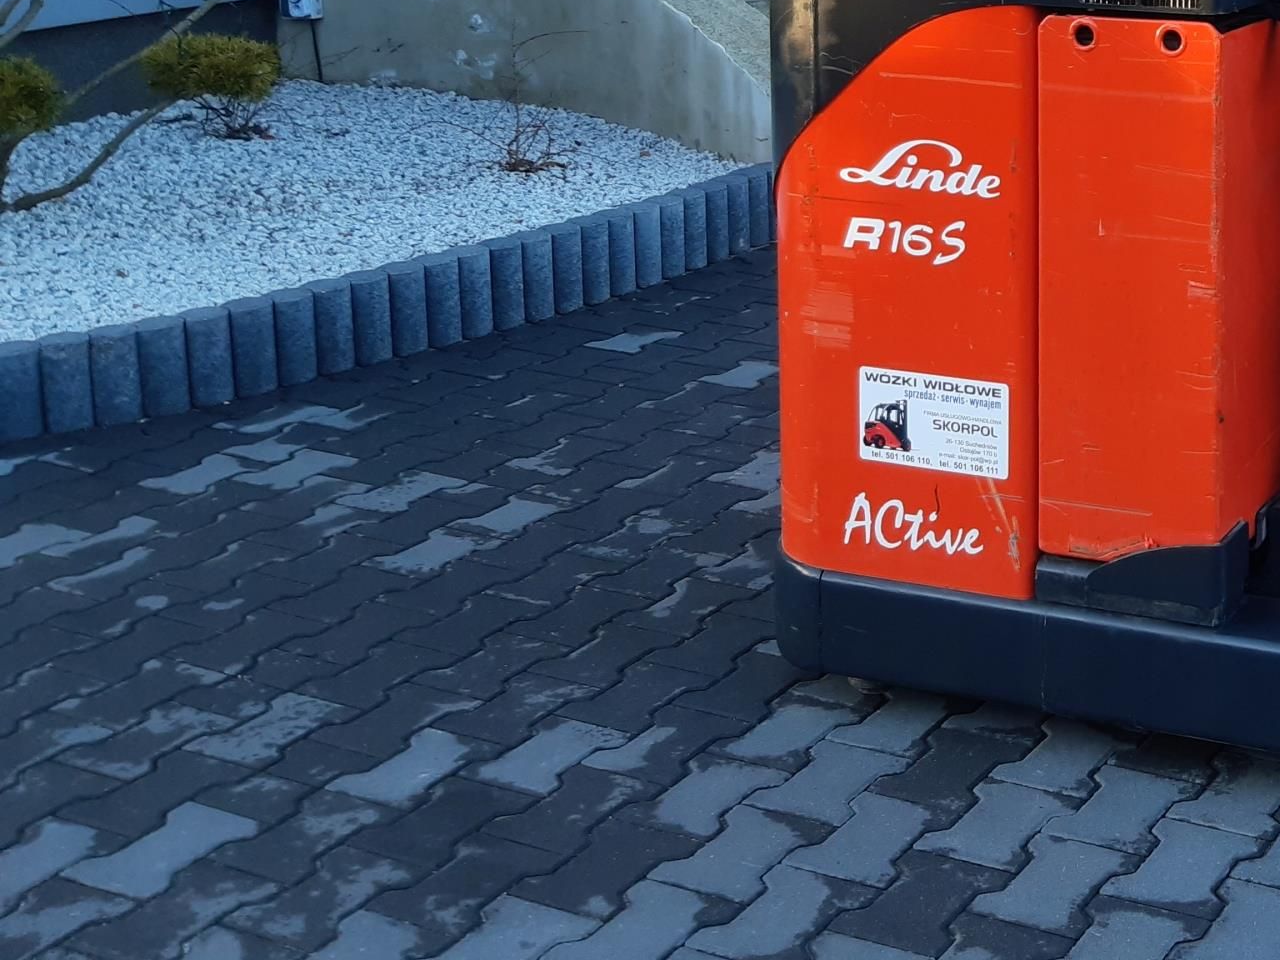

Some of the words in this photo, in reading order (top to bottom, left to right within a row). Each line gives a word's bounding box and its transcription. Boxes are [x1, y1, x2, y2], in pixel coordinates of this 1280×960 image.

[838, 139, 1001, 198] Linde
[865, 371, 917, 387] WÓZKI
[923, 379, 1002, 398] WIDŁOWE
[941, 393, 965, 405] serwis
[970, 397, 1002, 411] wynajem
[933, 419, 998, 438] SKORPOL
[871, 450, 883, 458] tel.
[885, 452, 898, 460] 501
[902, 454, 915, 463] 106
[953, 462, 967, 471] 501
[986, 466, 999, 475] 111
